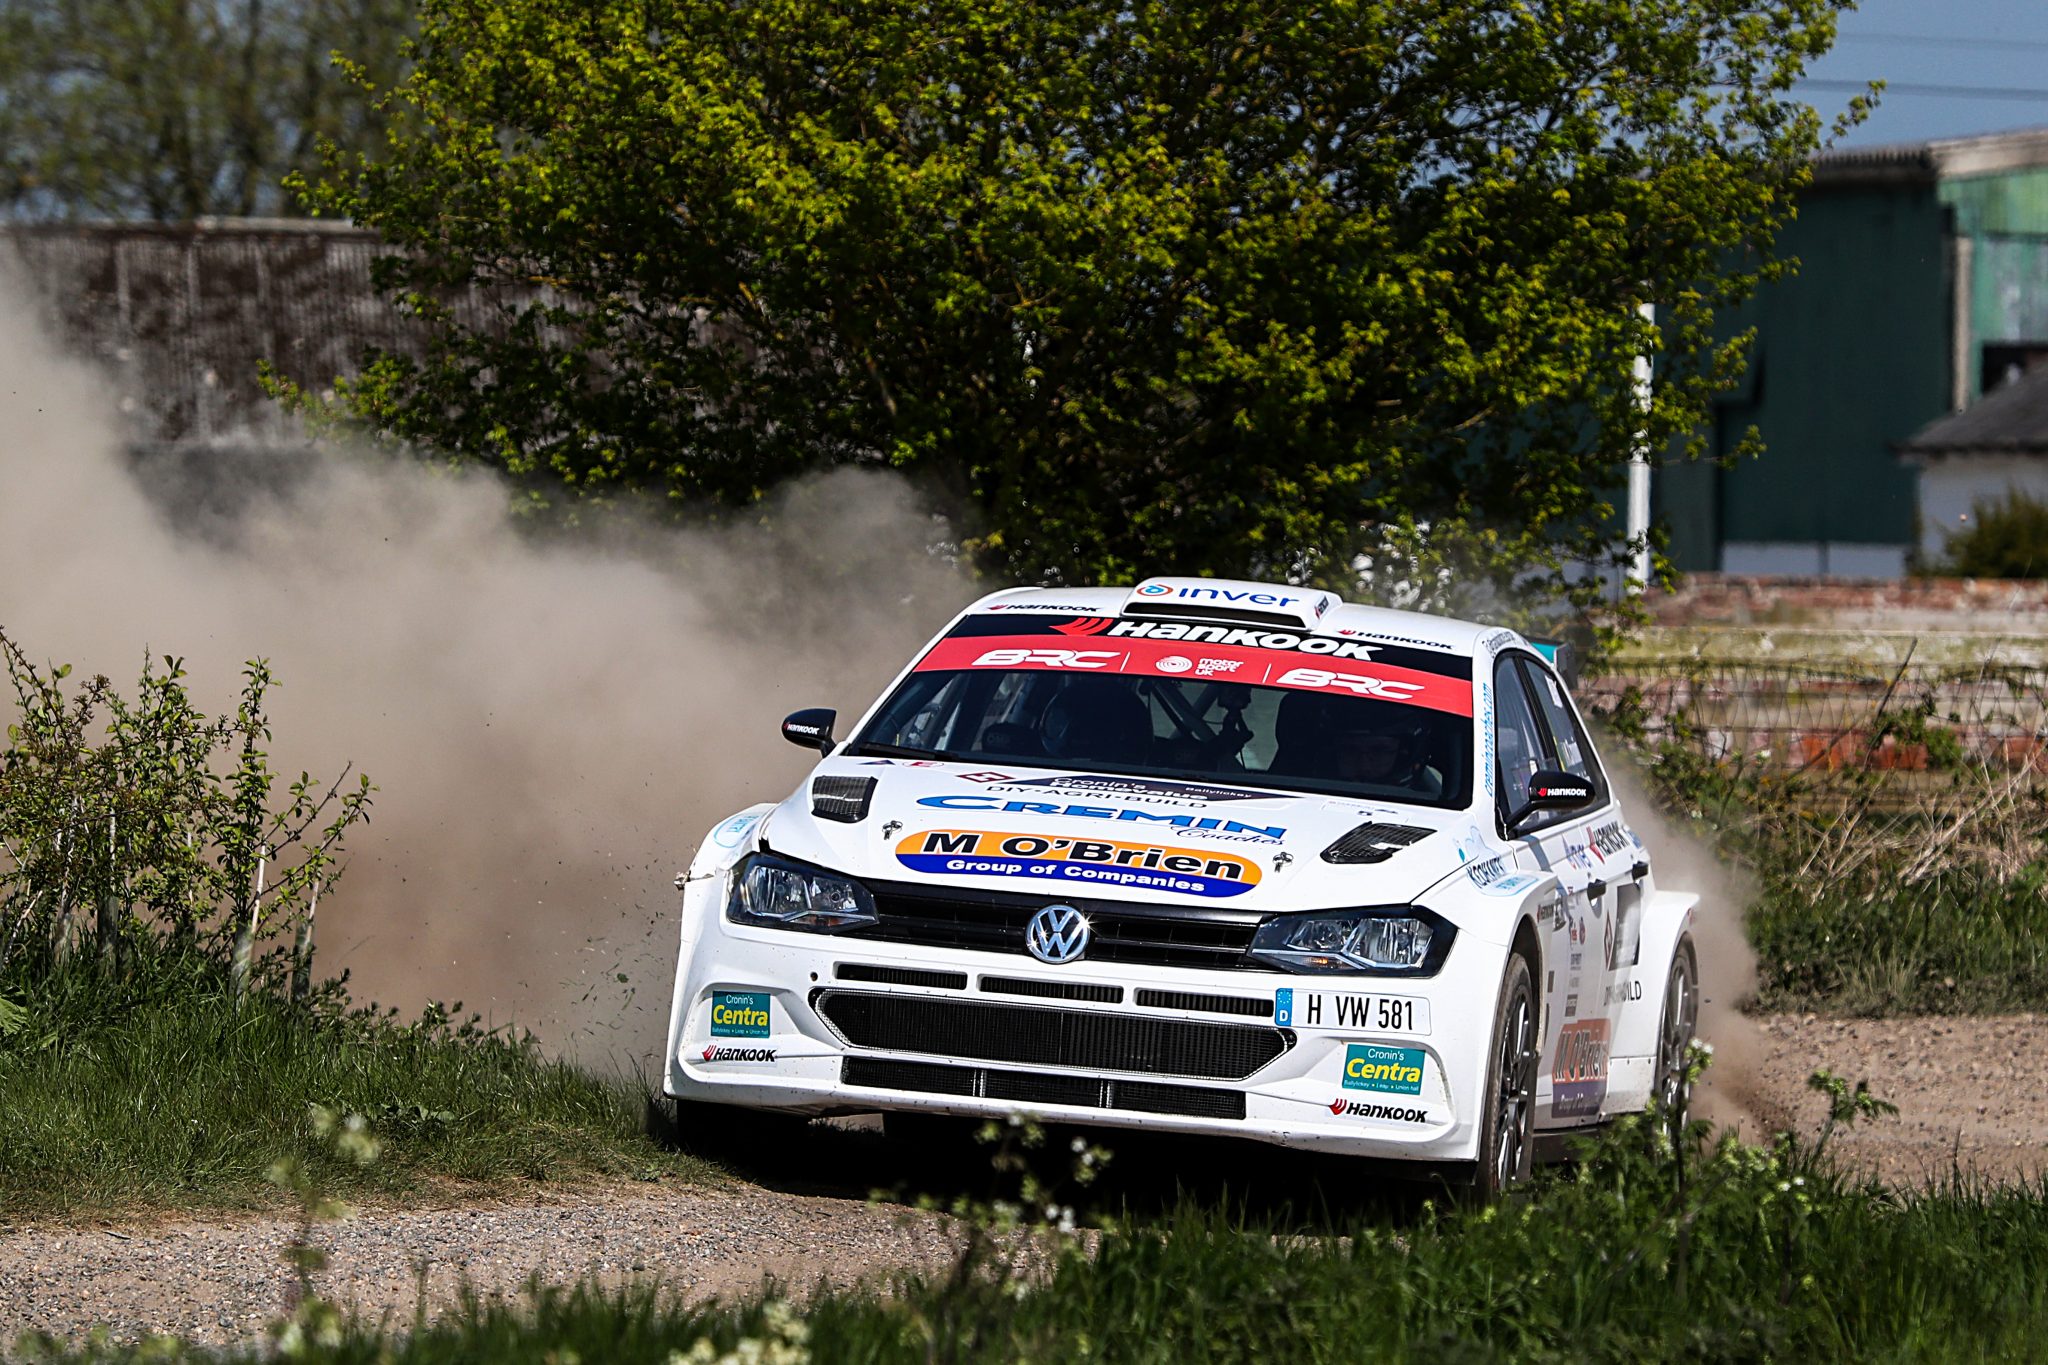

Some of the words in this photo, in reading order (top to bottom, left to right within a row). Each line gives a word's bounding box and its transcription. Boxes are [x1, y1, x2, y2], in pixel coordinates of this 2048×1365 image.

[1179, 588, 1299, 607] inver
[971, 649, 1121, 668] BRC
[1199, 658, 1244, 668] motor
[1276, 668, 1425, 700] BRC
[1480, 682, 1494, 798] cremincoaches.com
[1050, 781, 1209, 800] Homevalue
[1054, 777, 1147, 790] Cronin's
[916, 795, 1288, 840] CREMIN
[1170, 826, 1285, 846] Coaches
[922, 832, 978, 853] M
[1001, 836, 1244, 879] O'Brien
[946, 859, 1023, 875] Group
[1030, 864, 1057, 876] of
[1064, 865, 1206, 893] Companies
[726, 994, 754, 1005] Cronin's
[713, 1004, 768, 1026] Centra
[1279, 1009, 1289, 1022] D
[1307, 993, 1321, 1024] H
[1335, 995, 1370, 1027] VW
[1378, 999, 1413, 1031] 581
[1367, 1048, 1404, 1061] Cronin's
[1346, 1058, 1421, 1083] Centra
